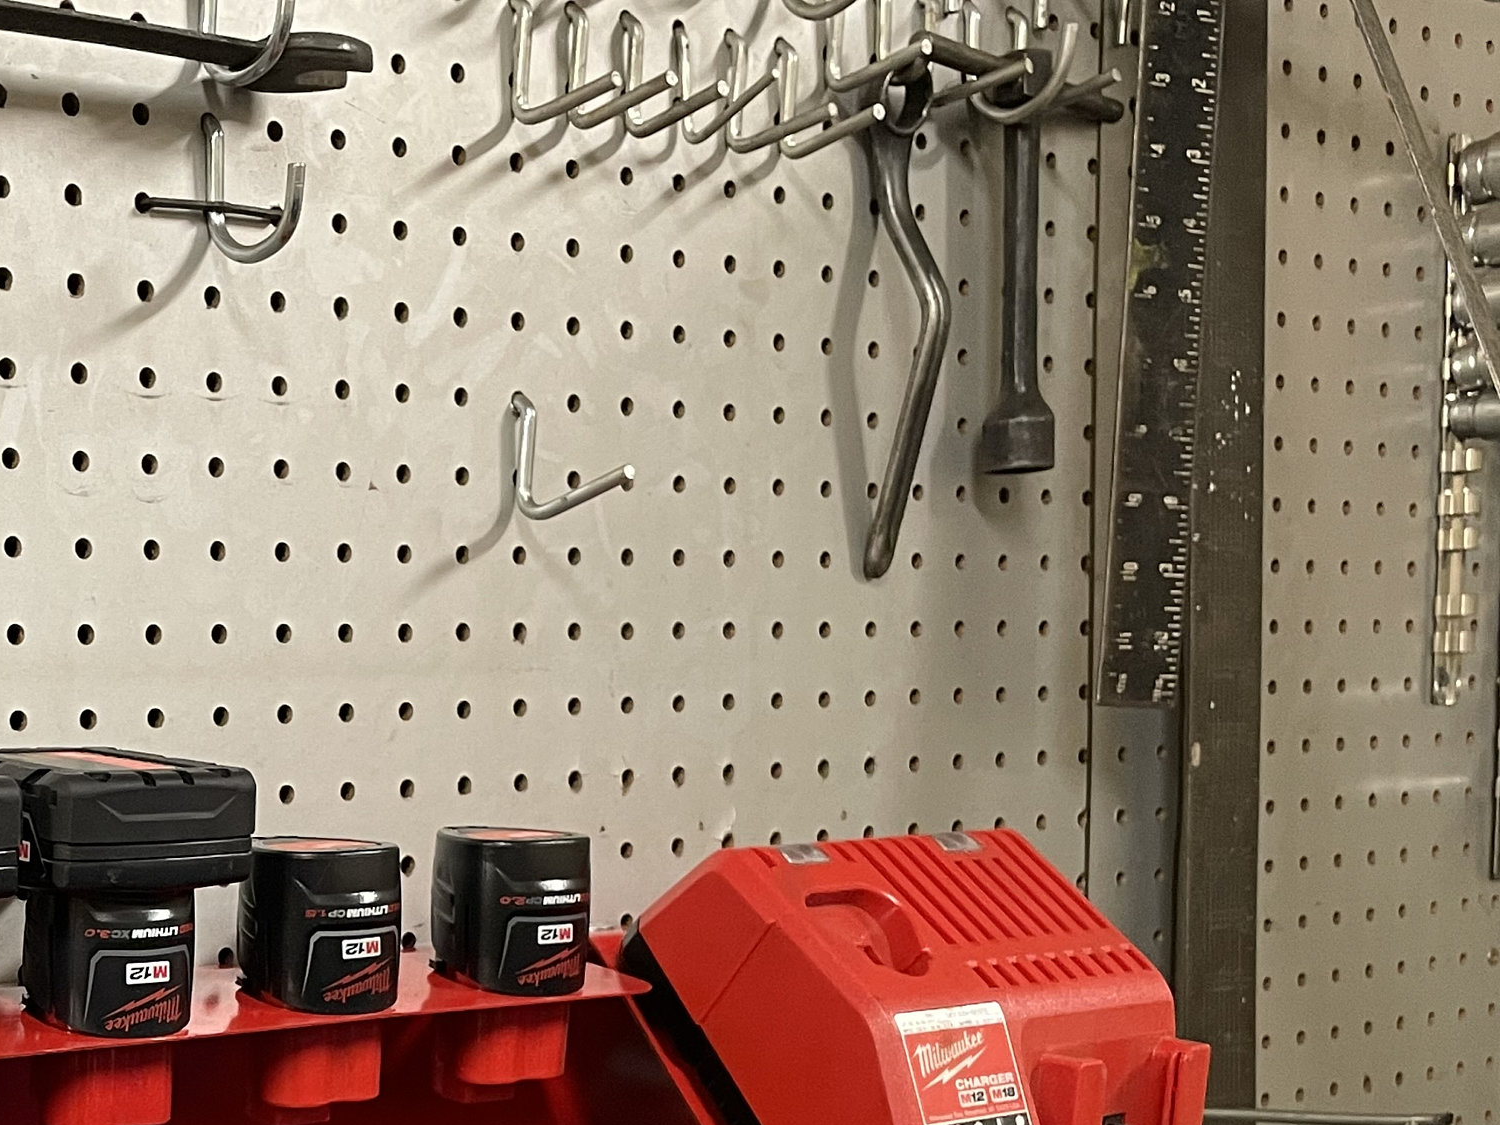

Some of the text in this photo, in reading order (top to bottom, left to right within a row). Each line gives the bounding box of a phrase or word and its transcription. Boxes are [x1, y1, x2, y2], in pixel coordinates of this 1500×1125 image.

[83, 928, 131, 940] XC3.0
[540, 927, 571, 941] M12
[344, 940, 380, 956] M12
[129, 965, 168, 980] M12
[322, 965, 391, 1004] Milwaukee
[103, 994, 183, 1032] Milwaukee
[913, 1029, 984, 1078] Milwaukee
[955, 1072, 1015, 1091] CHARGER
[961, 1086, 1016, 1104] M12 M18
